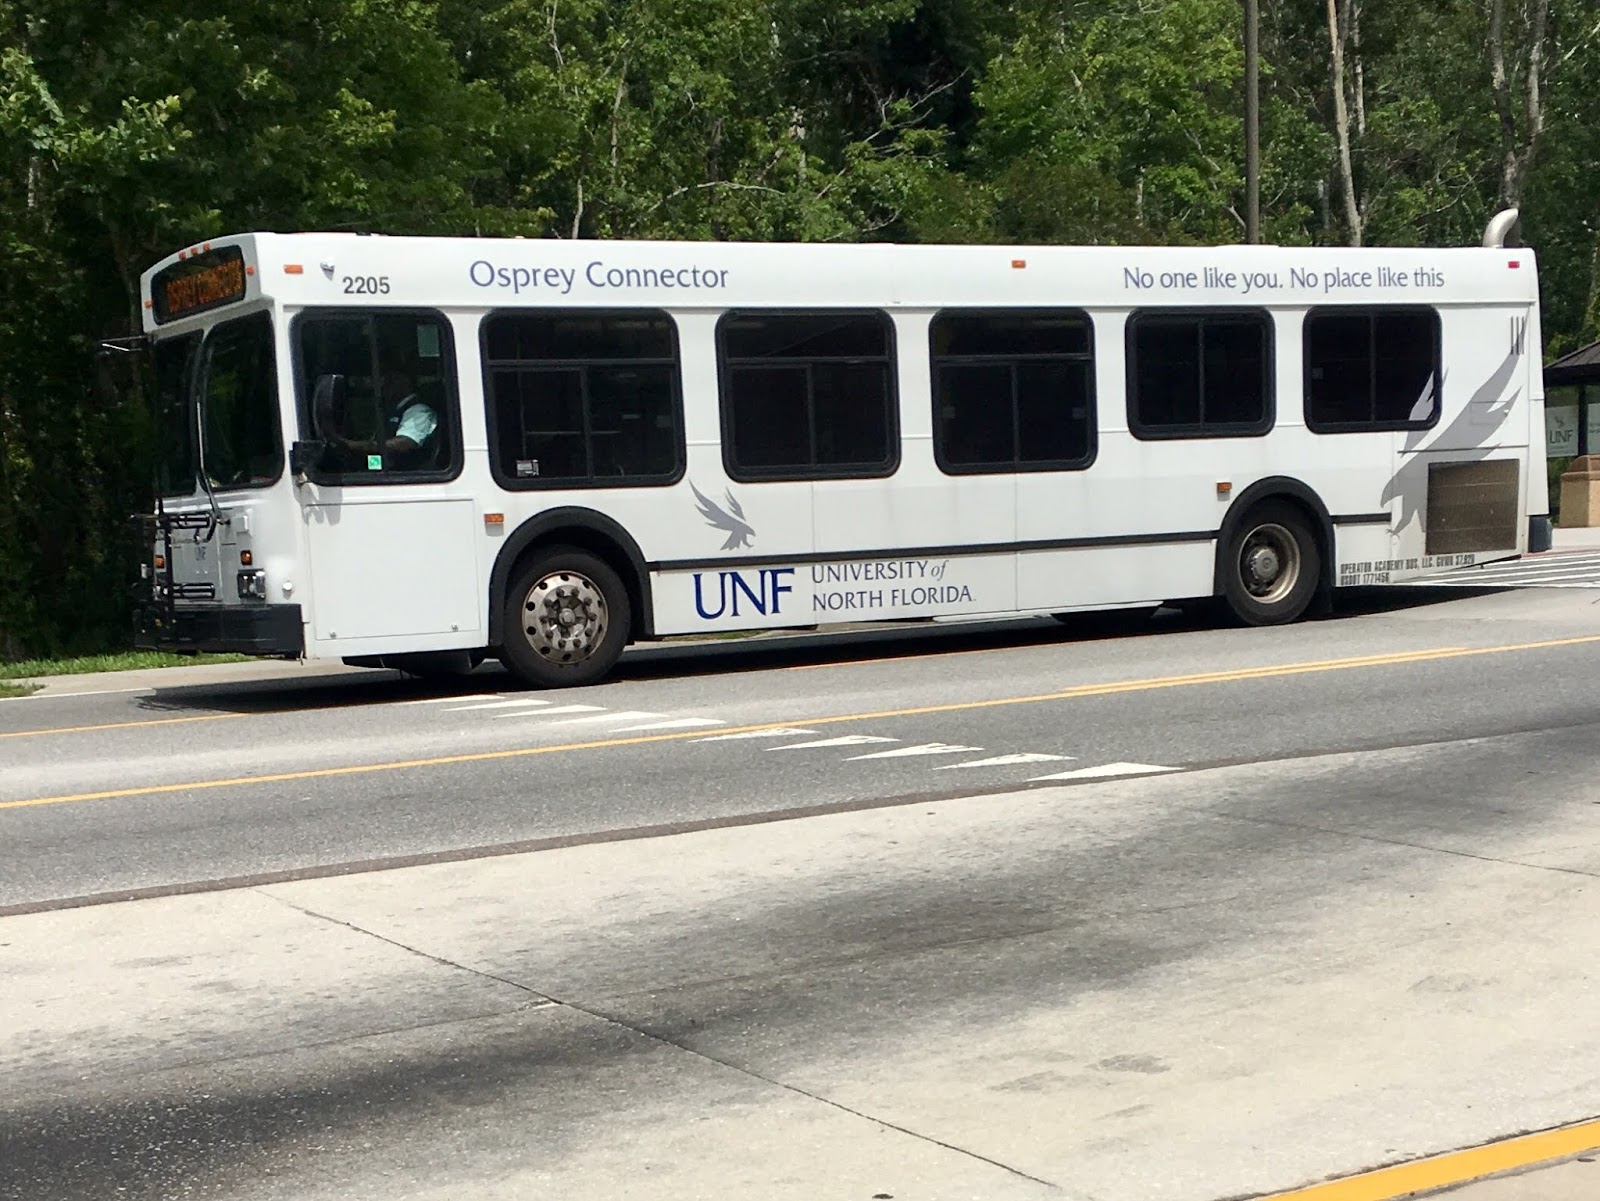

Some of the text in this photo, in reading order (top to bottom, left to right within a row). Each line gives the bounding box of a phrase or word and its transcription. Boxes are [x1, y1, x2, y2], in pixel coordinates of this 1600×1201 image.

[342, 276, 391, 294] 2205
[470, 260, 729, 294] Osprey Connector
[1123, 266, 1445, 294] No one like you. No place like this
[1549, 429, 1573, 444] UNF
[811, 560, 950, 584] UNIVERSITY of
[1340, 562, 1372, 575] OPERATOR
[692, 568, 795, 620] UNF
[812, 590, 883, 612] NORTH
